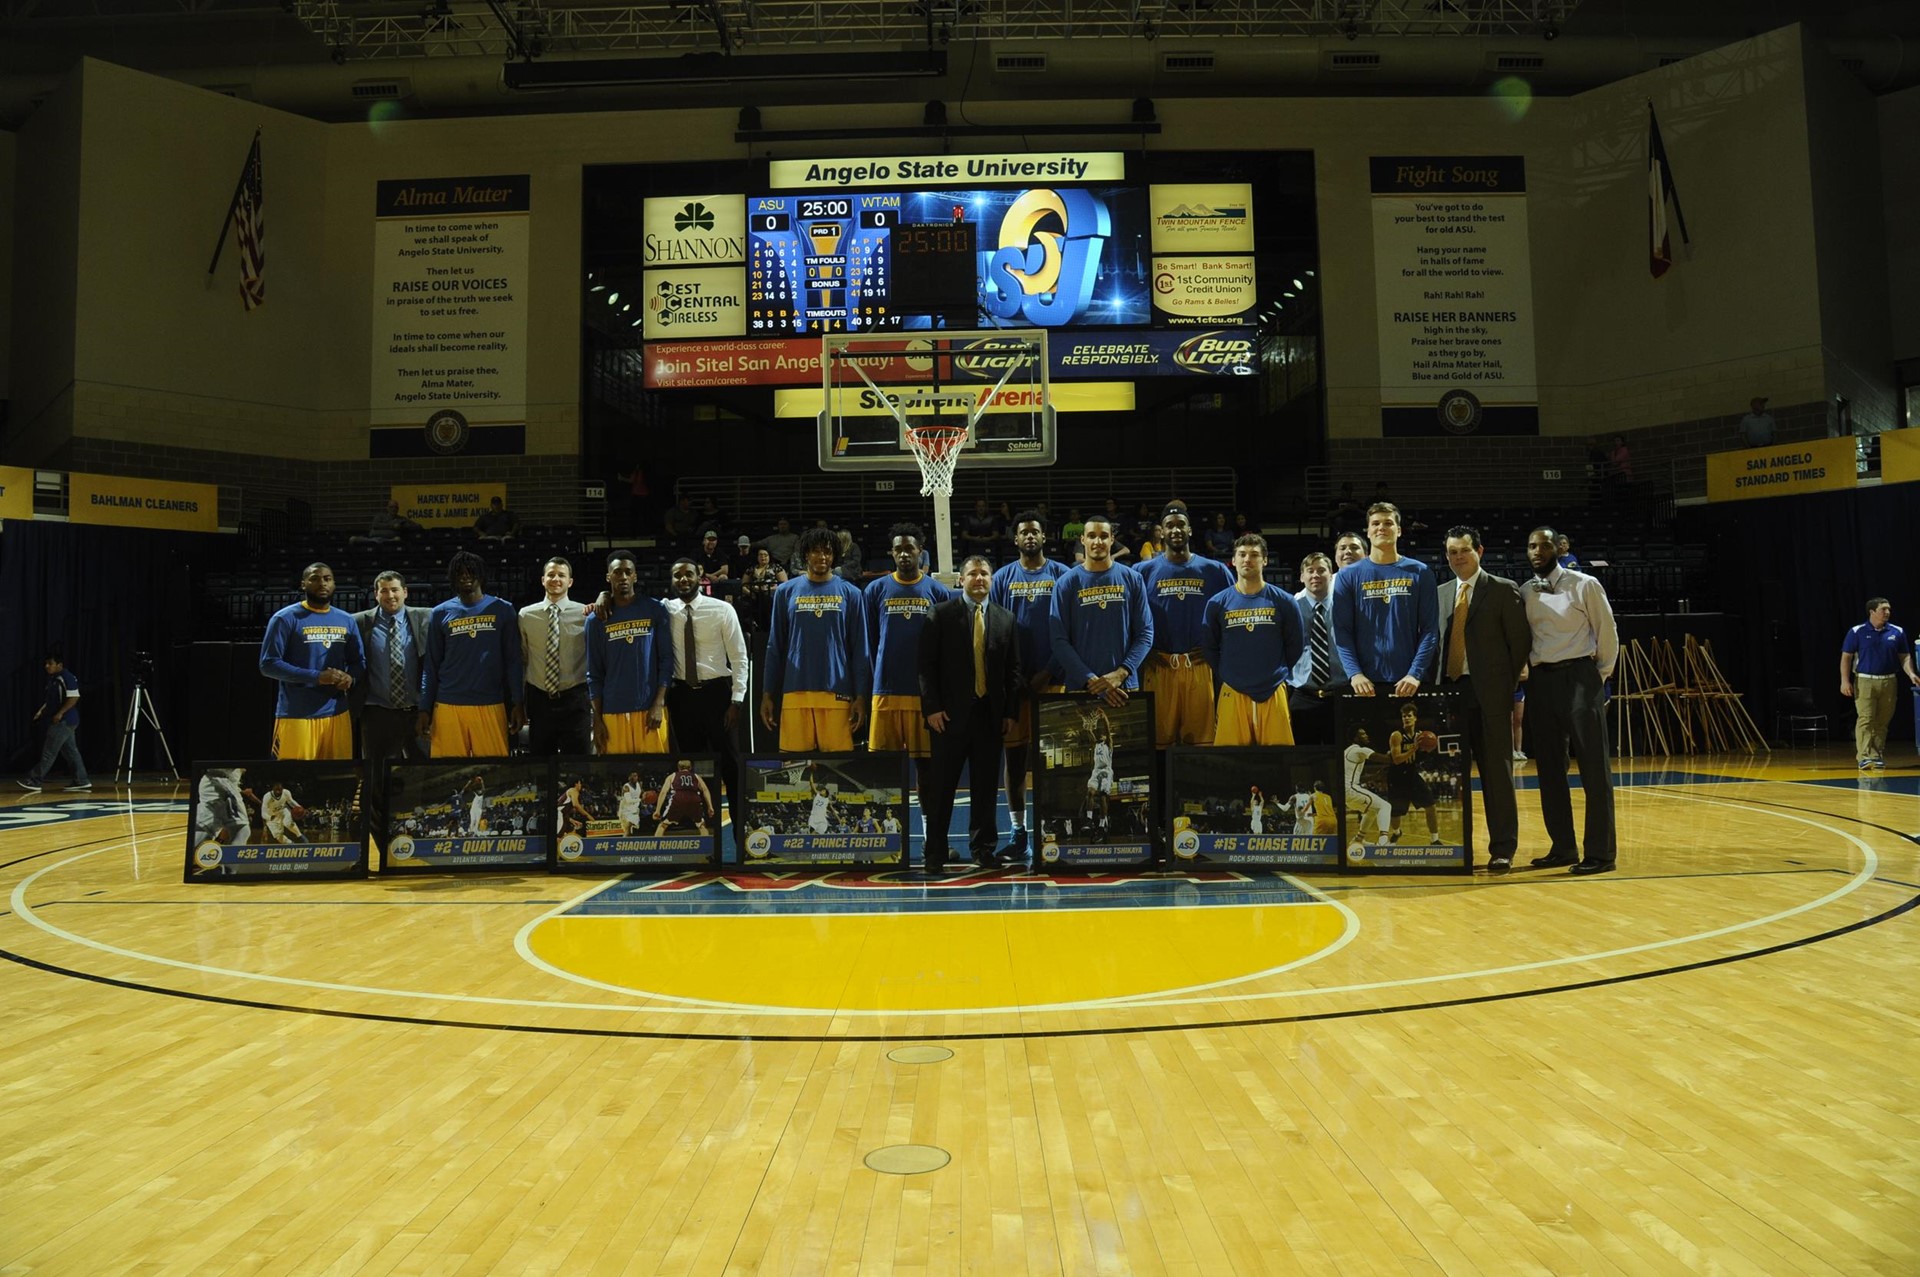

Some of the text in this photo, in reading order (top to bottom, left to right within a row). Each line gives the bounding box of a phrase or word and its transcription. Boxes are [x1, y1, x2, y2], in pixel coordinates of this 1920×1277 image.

[805, 158, 1089, 185] Angelo State University
[1396, 165, 1499, 188] Fight Song
[393, 186, 513, 207] Alma Mater
[758, 200, 784, 211] ASU
[861, 197, 900, 208] WTAM
[803, 202, 848, 217] 25:00
[766, 216, 776, 230] 0
[874, 213, 885, 227] 0
[1157, 217, 1176, 226] TWIN
[405, 222, 499, 233] In time to come when
[398, 248, 430, 258] Angelo
[432, 247, 455, 255] State
[644, 234, 744, 262] SHANNON
[806, 256, 845, 265] TM FOULS
[1202, 262, 1222, 270] Bank
[1225, 262, 1252, 270] Smart!
[427, 266, 474, 276] Then let us
[809, 267, 815, 277] 0
[835, 267, 842, 277] 0
[393, 278, 507, 292] RAISE OUR VOICES
[812, 280, 840, 288] BONUS
[1160, 280, 1173, 288] 1st
[1177, 274, 1253, 286] 1st Community
[1186, 285, 1242, 293] Credit Union
[1424, 290, 1485, 299] Rah! Rah! Rah!
[666, 295, 740, 312] CENTRAL
[806, 309, 847, 317] TIMEOUTS
[1394, 311, 1517, 322] RAISE HER BANNERS
[811, 320, 819, 329] 4
[833, 319, 841, 329] 4
[1168, 317, 1244, 325] www.1cfcu.org
[656, 344, 699, 356] Experience
[710, 343, 758, 353] world-class
[760, 342, 788, 350] career.
[1073, 344, 1149, 355] CELEBRATE
[1197, 340, 1252, 352] BUD
[1061, 354, 1159, 366] RESPONSIBLY.
[1186, 352, 1255, 364] LIGHT
[656, 358, 691, 374] Join
[696, 356, 735, 373] Sitel
[737, 356, 770, 372] San
[1412, 372, 1431, 380] Blue
[1433, 372, 1449, 380] and
[1451, 372, 1471, 380] Gold
[1473, 371, 1482, 380] of
[656, 375, 747, 388] Visit sitel.com/careers
[1007, 441, 1042, 452] Schelde
[1746, 453, 1812, 471] SAN ANGELO
[1545, 471, 1561, 479] 116
[1735, 467, 1825, 488] STANDARD TIMES
[878, 482, 893, 490] 115
[417, 493, 480, 504] HARKEY RANCH
[588, 489, 604, 497] 114
[91, 494, 198, 513] BAHLMAN CLEANERS
[407, 509, 433, 519] CHASE
[436, 508, 441, 518] &
[443, 508, 468, 518] JAMIE
[1157, 579, 1204, 589] ANGELO STATE
[1160, 586, 1201, 594] BASKETBALL
[1224, 609, 1275, 620] ANGELO STATE
[604, 620, 652, 633] ANGELO STATE
[1228, 616, 1272, 626] BASKETBALL
[609, 627, 649, 639] BASKETBALL
[434, 838, 527, 854] #2 QUAY KING
[595, 842, 609, 852] #4
[658, 840, 700, 850] RHOADES
[783, 836, 887, 848] #22 PRINCE FOSTER
[1213, 837, 1327, 851] #15 CHASE RILEY
[237, 849, 259, 859] #32
[313, 846, 344, 857] PRATT
[1243, 855, 1276, 863] SPRINGS,
[1277, 855, 1308, 863] WYOMING
